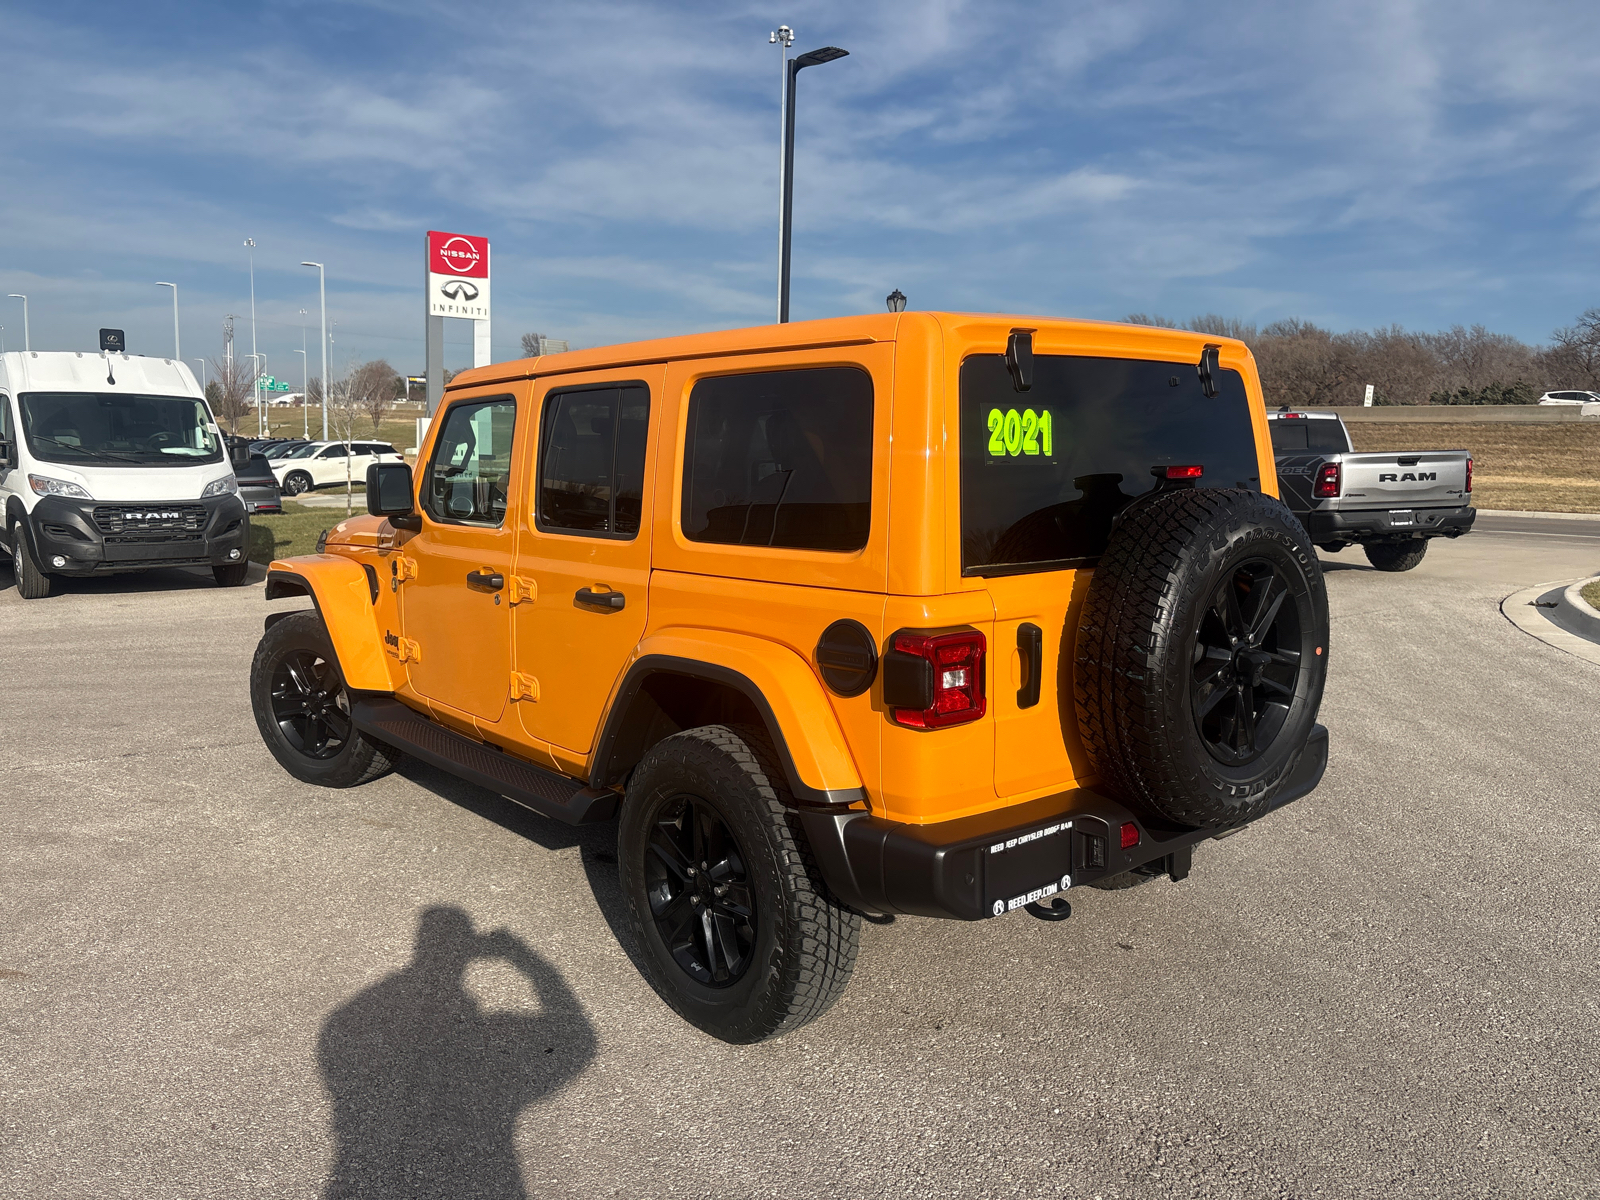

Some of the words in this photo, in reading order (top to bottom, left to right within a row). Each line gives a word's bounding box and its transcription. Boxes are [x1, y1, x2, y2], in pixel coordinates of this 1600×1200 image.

[440, 249, 480, 260] NISSAN
[433, 303, 487, 316] INFINITI
[987, 408, 1052, 457] 2021
[1277, 466, 1312, 476] EBEL
[1379, 472, 1437, 483] RAM
[125, 512, 179, 520] RAM
[990, 842, 1004, 854] REED
[1005, 838, 1017, 849] JEEP
[1018, 830, 1043, 845] CHRYSLER
[1060, 821, 1072, 831] RAM
[1008, 883, 1058, 911] REEDJEEP.COM
